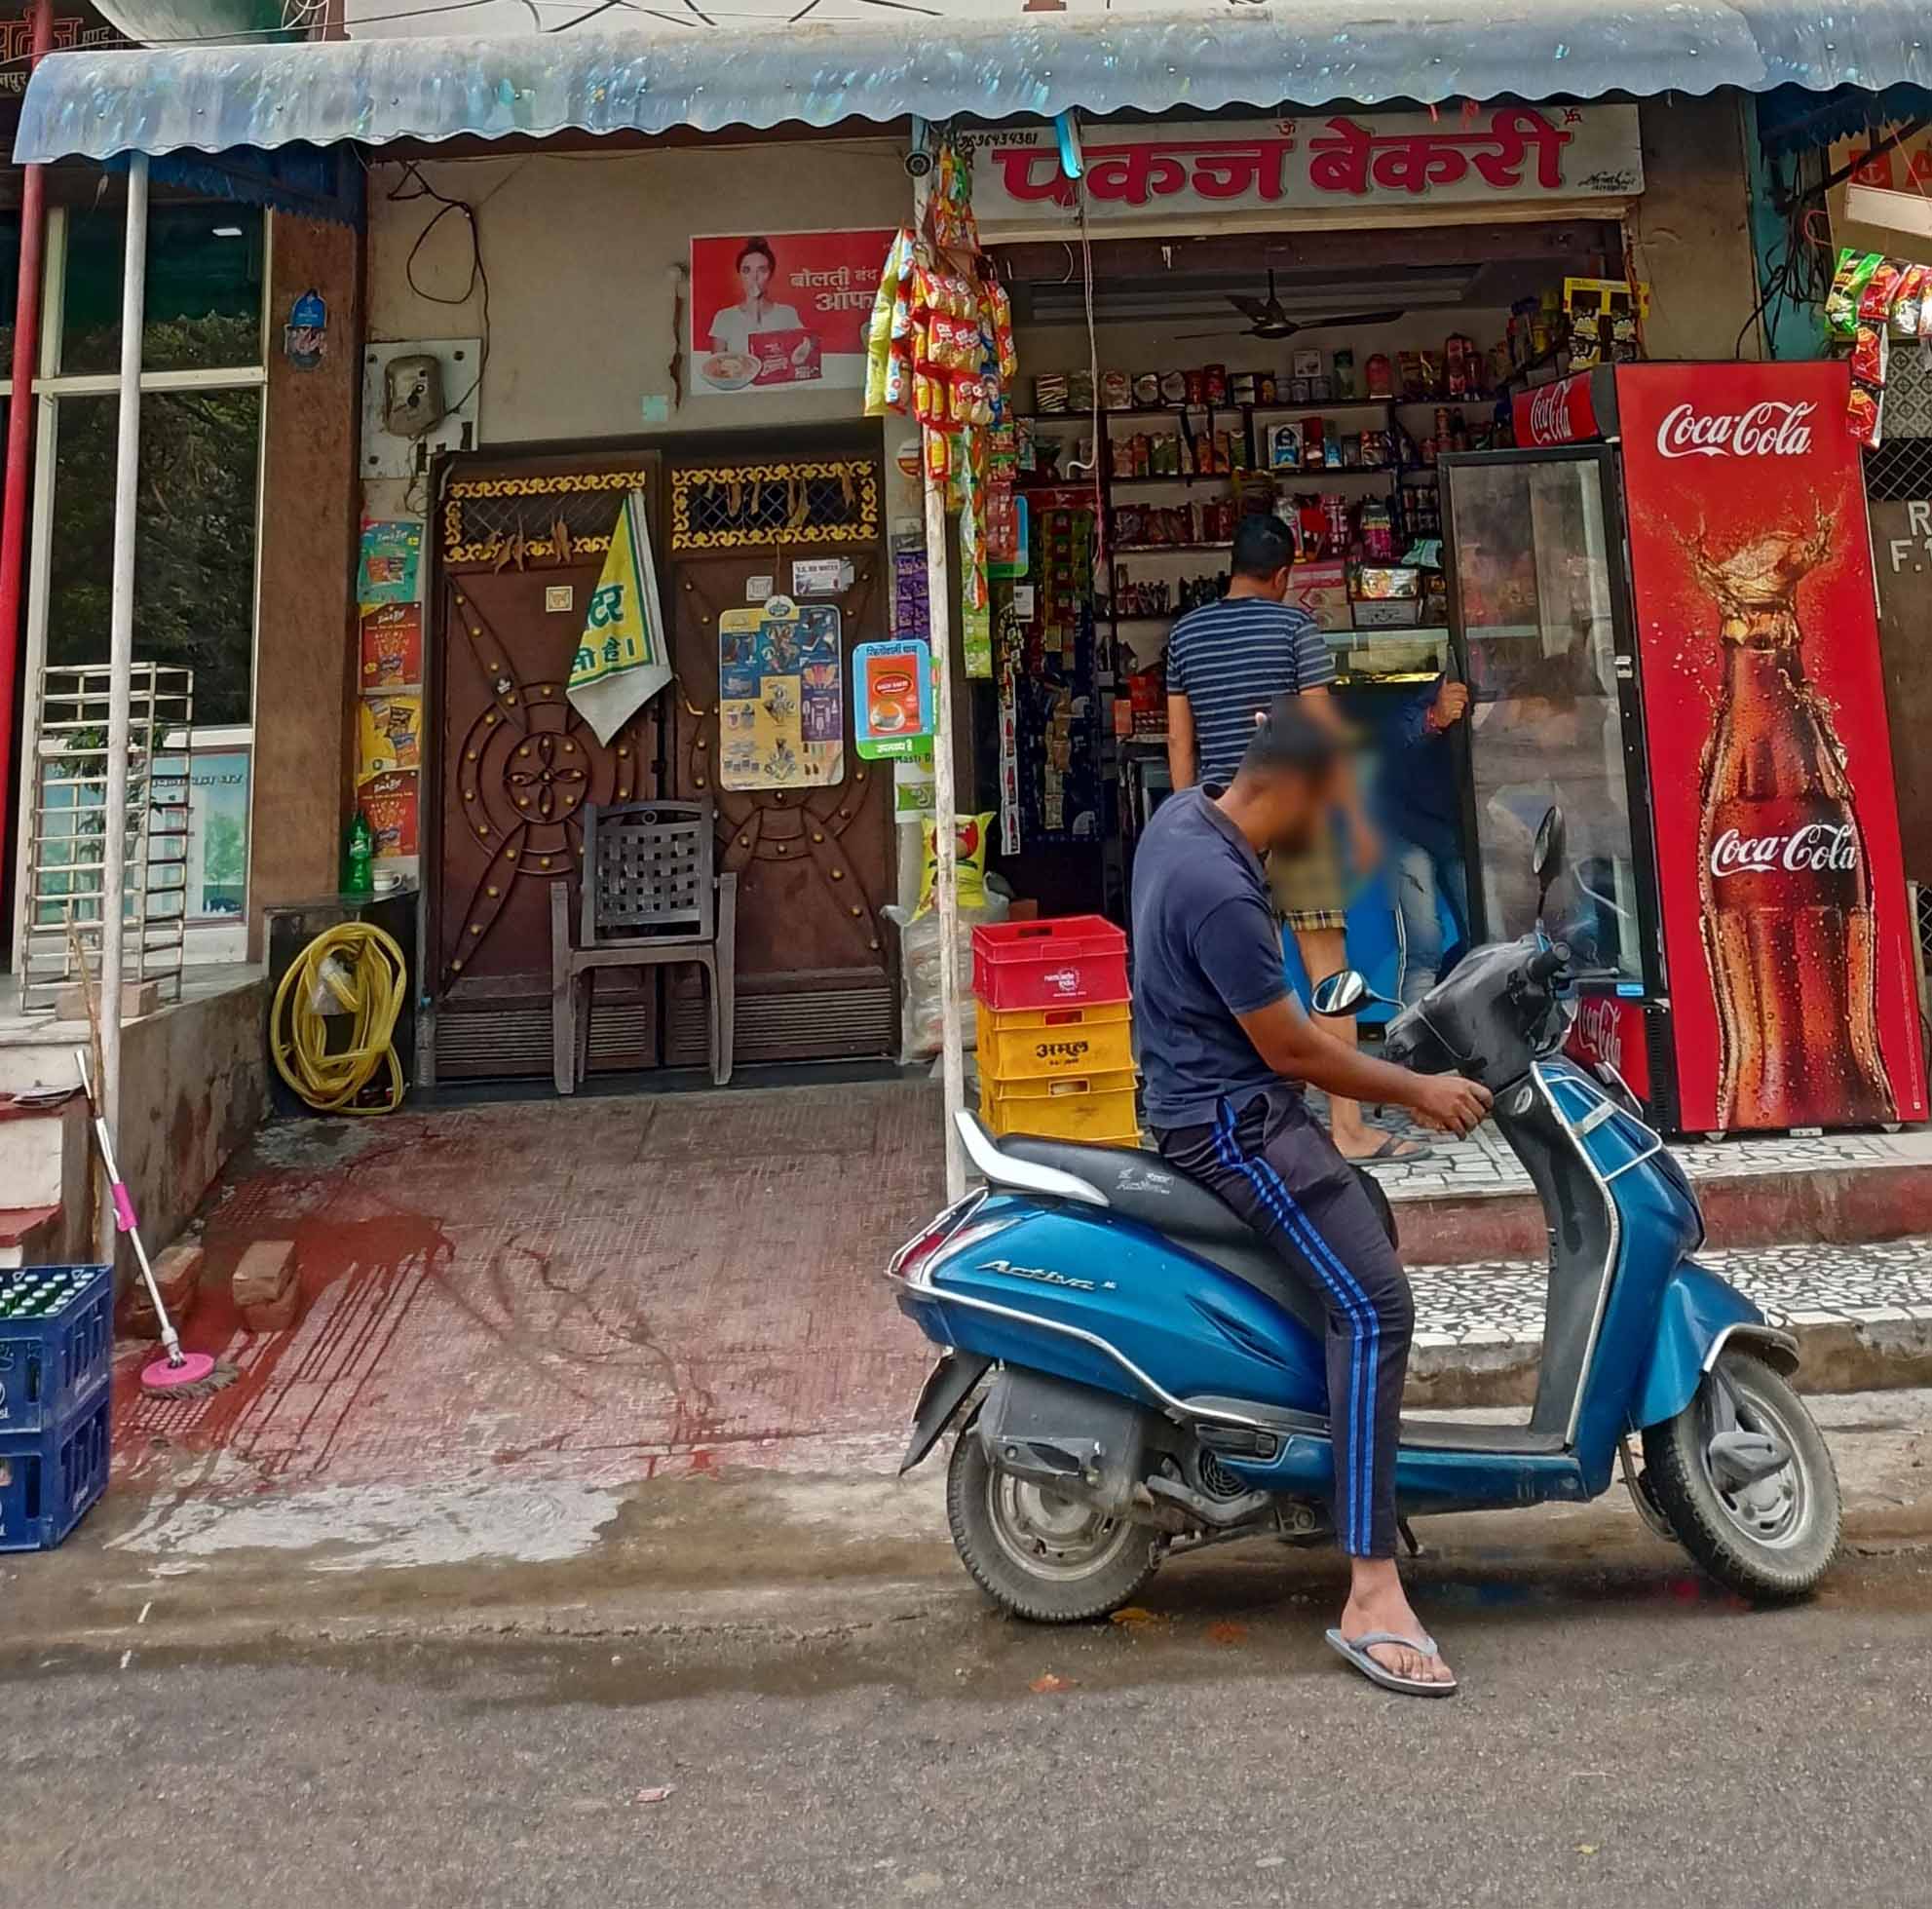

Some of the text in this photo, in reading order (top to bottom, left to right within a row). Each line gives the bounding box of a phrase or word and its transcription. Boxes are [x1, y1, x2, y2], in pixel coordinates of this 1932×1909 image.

[1308, 106, 1572, 195] बेकरी
[789, 265, 851, 288] बोलती
[1656, 401, 1818, 459] Coca-Cola
[1710, 823, 1858, 878] Coca-Cola
[975, 1259, 1095, 1290] Activa
